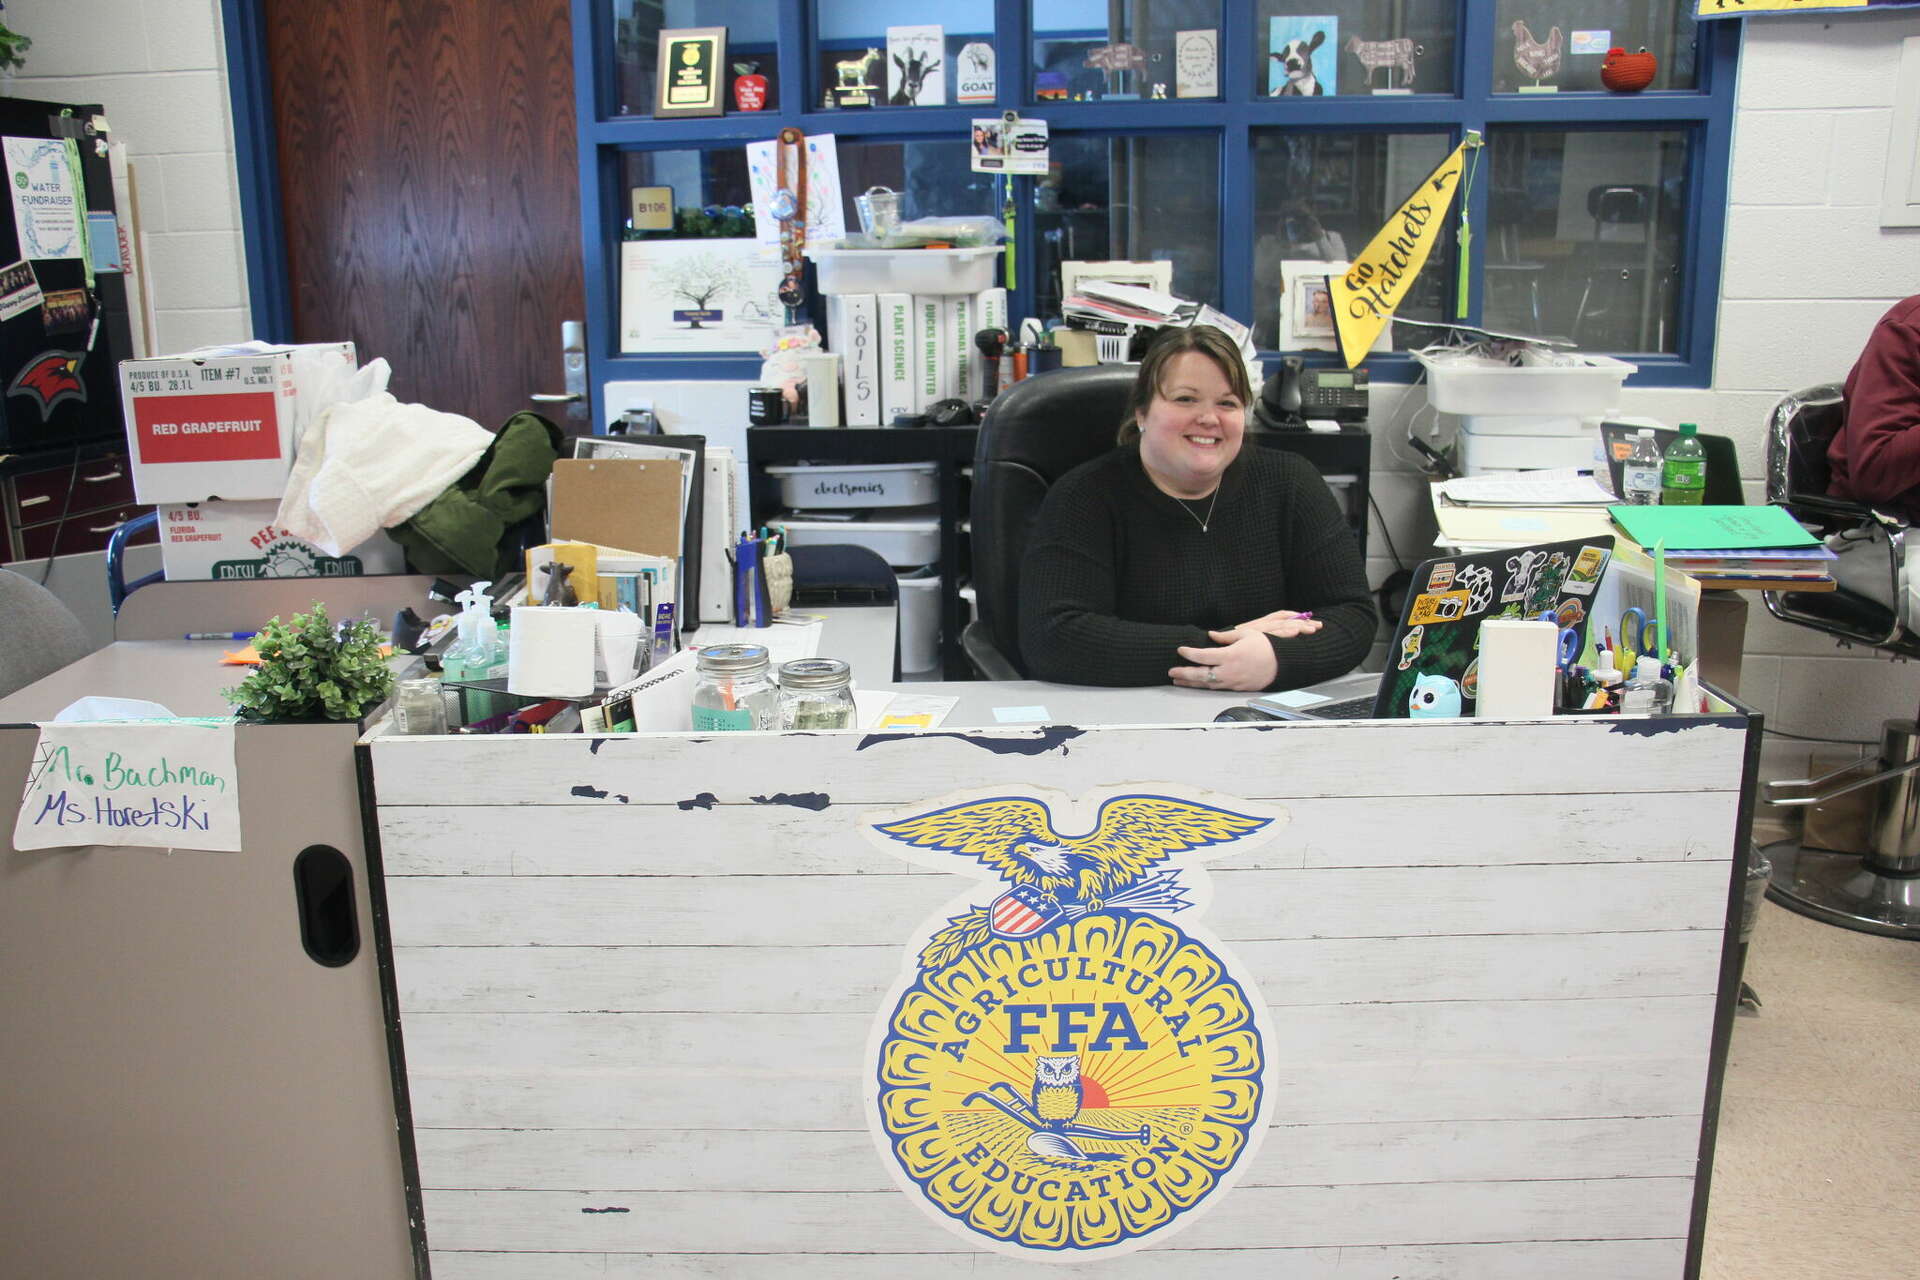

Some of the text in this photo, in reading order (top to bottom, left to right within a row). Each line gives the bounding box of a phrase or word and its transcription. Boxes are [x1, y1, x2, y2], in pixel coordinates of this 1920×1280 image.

[961, 82, 994, 92] GOAT
[31, 183, 61, 193] WATER
[21, 195, 73, 206] FUNDRAISER
[639, 203, 667, 213] B106
[1349, 198, 1432, 320] Hatchets
[894, 305, 905, 381] PLANT SCIENCE
[925, 304, 937, 395] DUCKS UNLIMITED
[957, 301, 968, 394] PERSONAL FINANCE
[855, 315, 870, 400] SOILS
[129, 370, 159, 379] PRODUCE
[161, 370, 169, 378] OF
[201, 367, 241, 381] ITEM #7
[130, 381, 145, 392] 4/5
[149, 380, 163, 391] BU.
[168, 380, 186, 391] 28.1
[152, 419, 262, 435] RED GRAPEFRUIT
[814, 479, 885, 497] electronics
[168, 511, 204, 522] 4/5 BU.
[170, 526, 196, 534] FLORIDA
[185, 533, 222, 542] GRAPEFRUIT
[250, 525, 277, 549] PEE
[103, 752, 225, 792] Bachman
[940, 956, 1203, 1064] AGRICULTURAL
[1002, 1001, 1149, 1054] FFA
[963, 1133, 1181, 1203] EDUCATION
